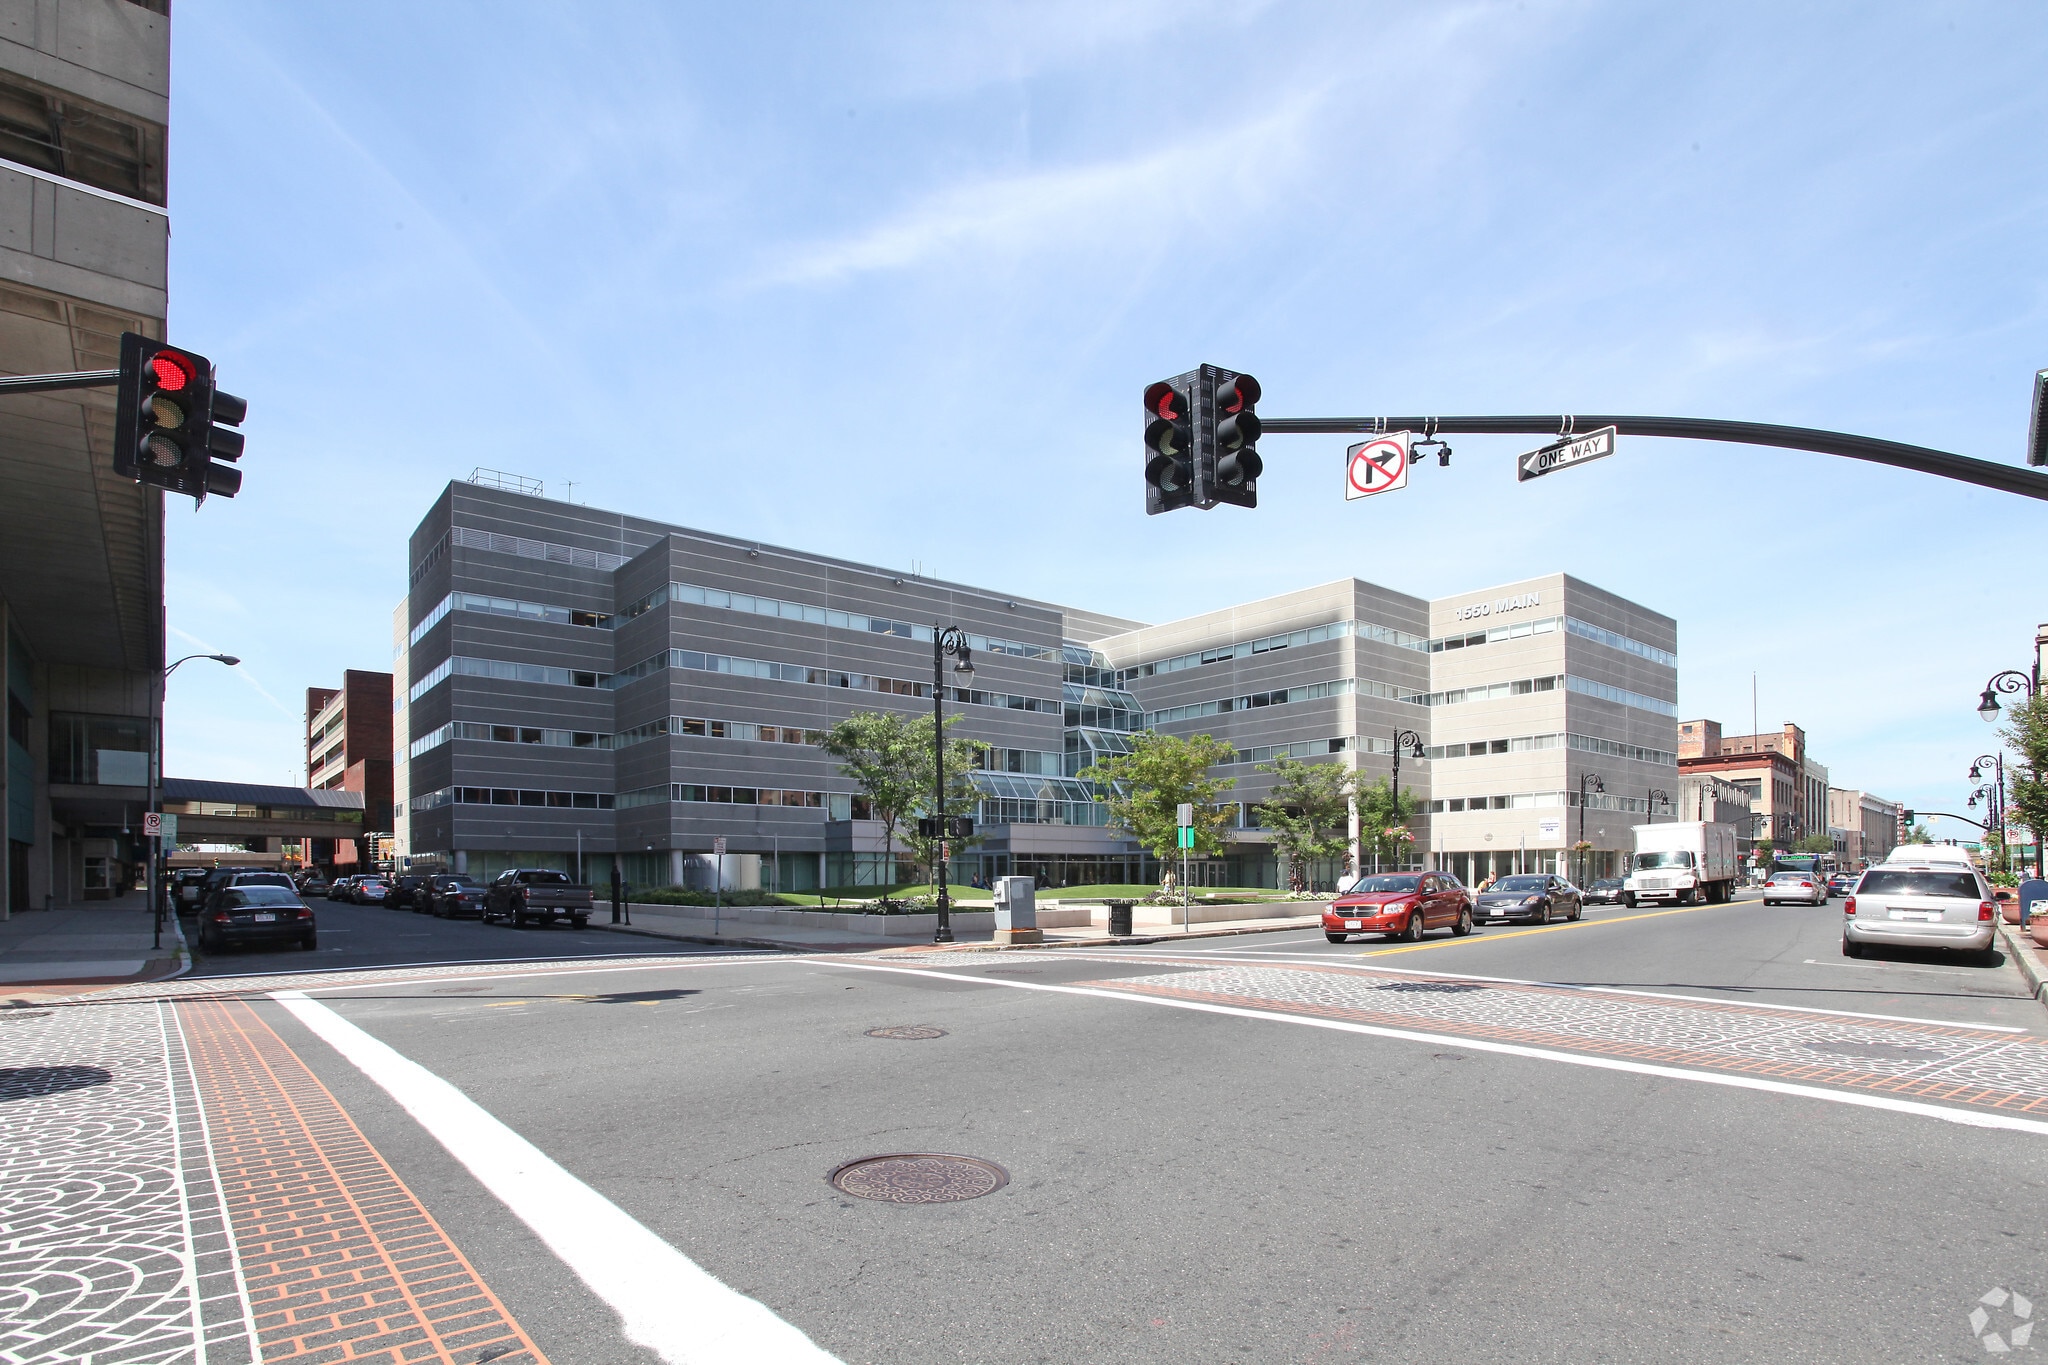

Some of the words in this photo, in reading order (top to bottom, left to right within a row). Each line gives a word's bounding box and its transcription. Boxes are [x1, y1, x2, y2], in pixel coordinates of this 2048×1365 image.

[1539, 448, 1566, 468] ONE
[1571, 438, 1601, 459] WAY
[1456, 603, 1491, 621] 1550
[1495, 592, 1540, 614] MAIN
